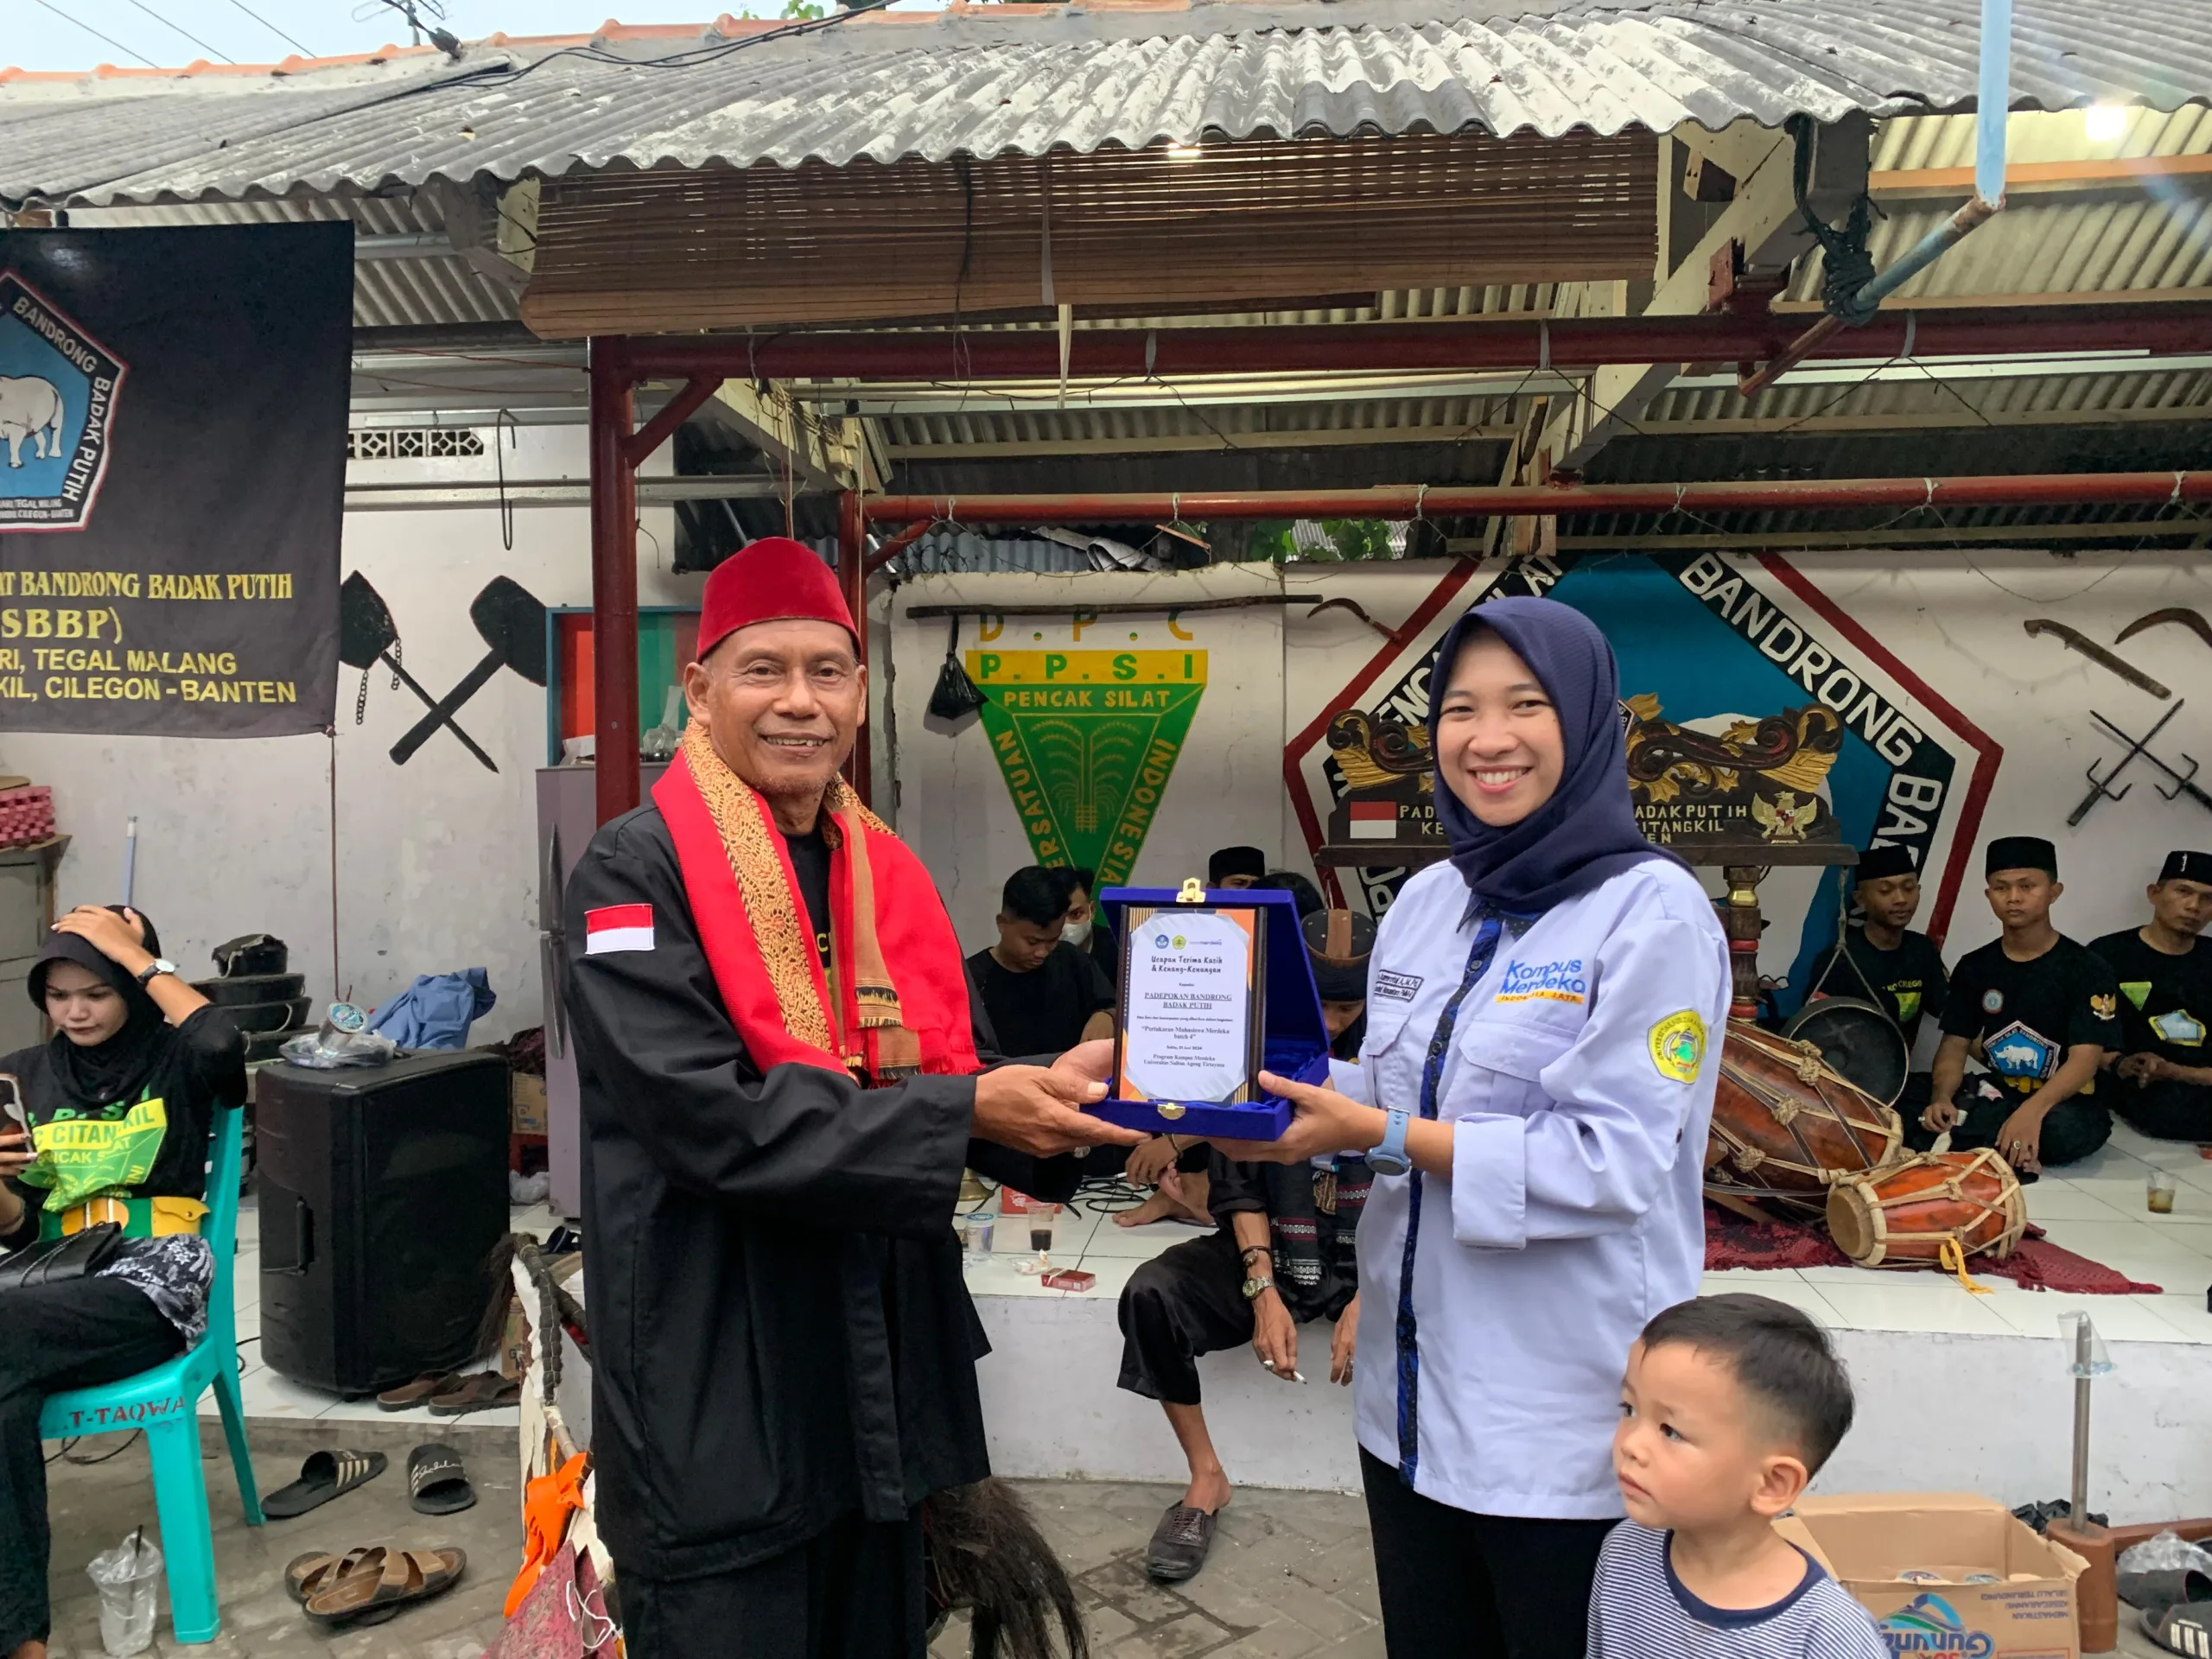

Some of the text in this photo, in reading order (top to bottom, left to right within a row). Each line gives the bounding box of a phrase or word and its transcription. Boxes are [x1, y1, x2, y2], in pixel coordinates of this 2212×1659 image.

[13, 296, 111, 502] BANDRONG BADAK PUTIH
[20, 571, 141, 598] BANDRONG
[148, 574, 222, 600] BADAK
[226, 573, 293, 600] PUTIH
[32, 649, 121, 671] TEGAL
[127, 650, 238, 675] MALANG
[1679, 552, 1923, 767] BANDRONG
[45, 677, 162, 701] CILEGON
[182, 679, 297, 704] BANTEN
[1004, 690, 1171, 708] PENCAK SILAT
[995, 729, 1065, 868] ERSATUAN
[1400, 804, 1439, 819] PAD
[1635, 804, 1681, 819] ADAK
[1100, 739, 1177, 885] INDONESIA
[1637, 820, 1725, 833] ITANGKIL
[1151, 956, 1176, 964] Ucapan
[1159, 965, 1221, 975] Kenang-Kenangan
[1506, 959, 1582, 980] Kampus
[1499, 972, 1586, 995] Merdeka
[52, 1106, 156, 1144] CITANKIL
